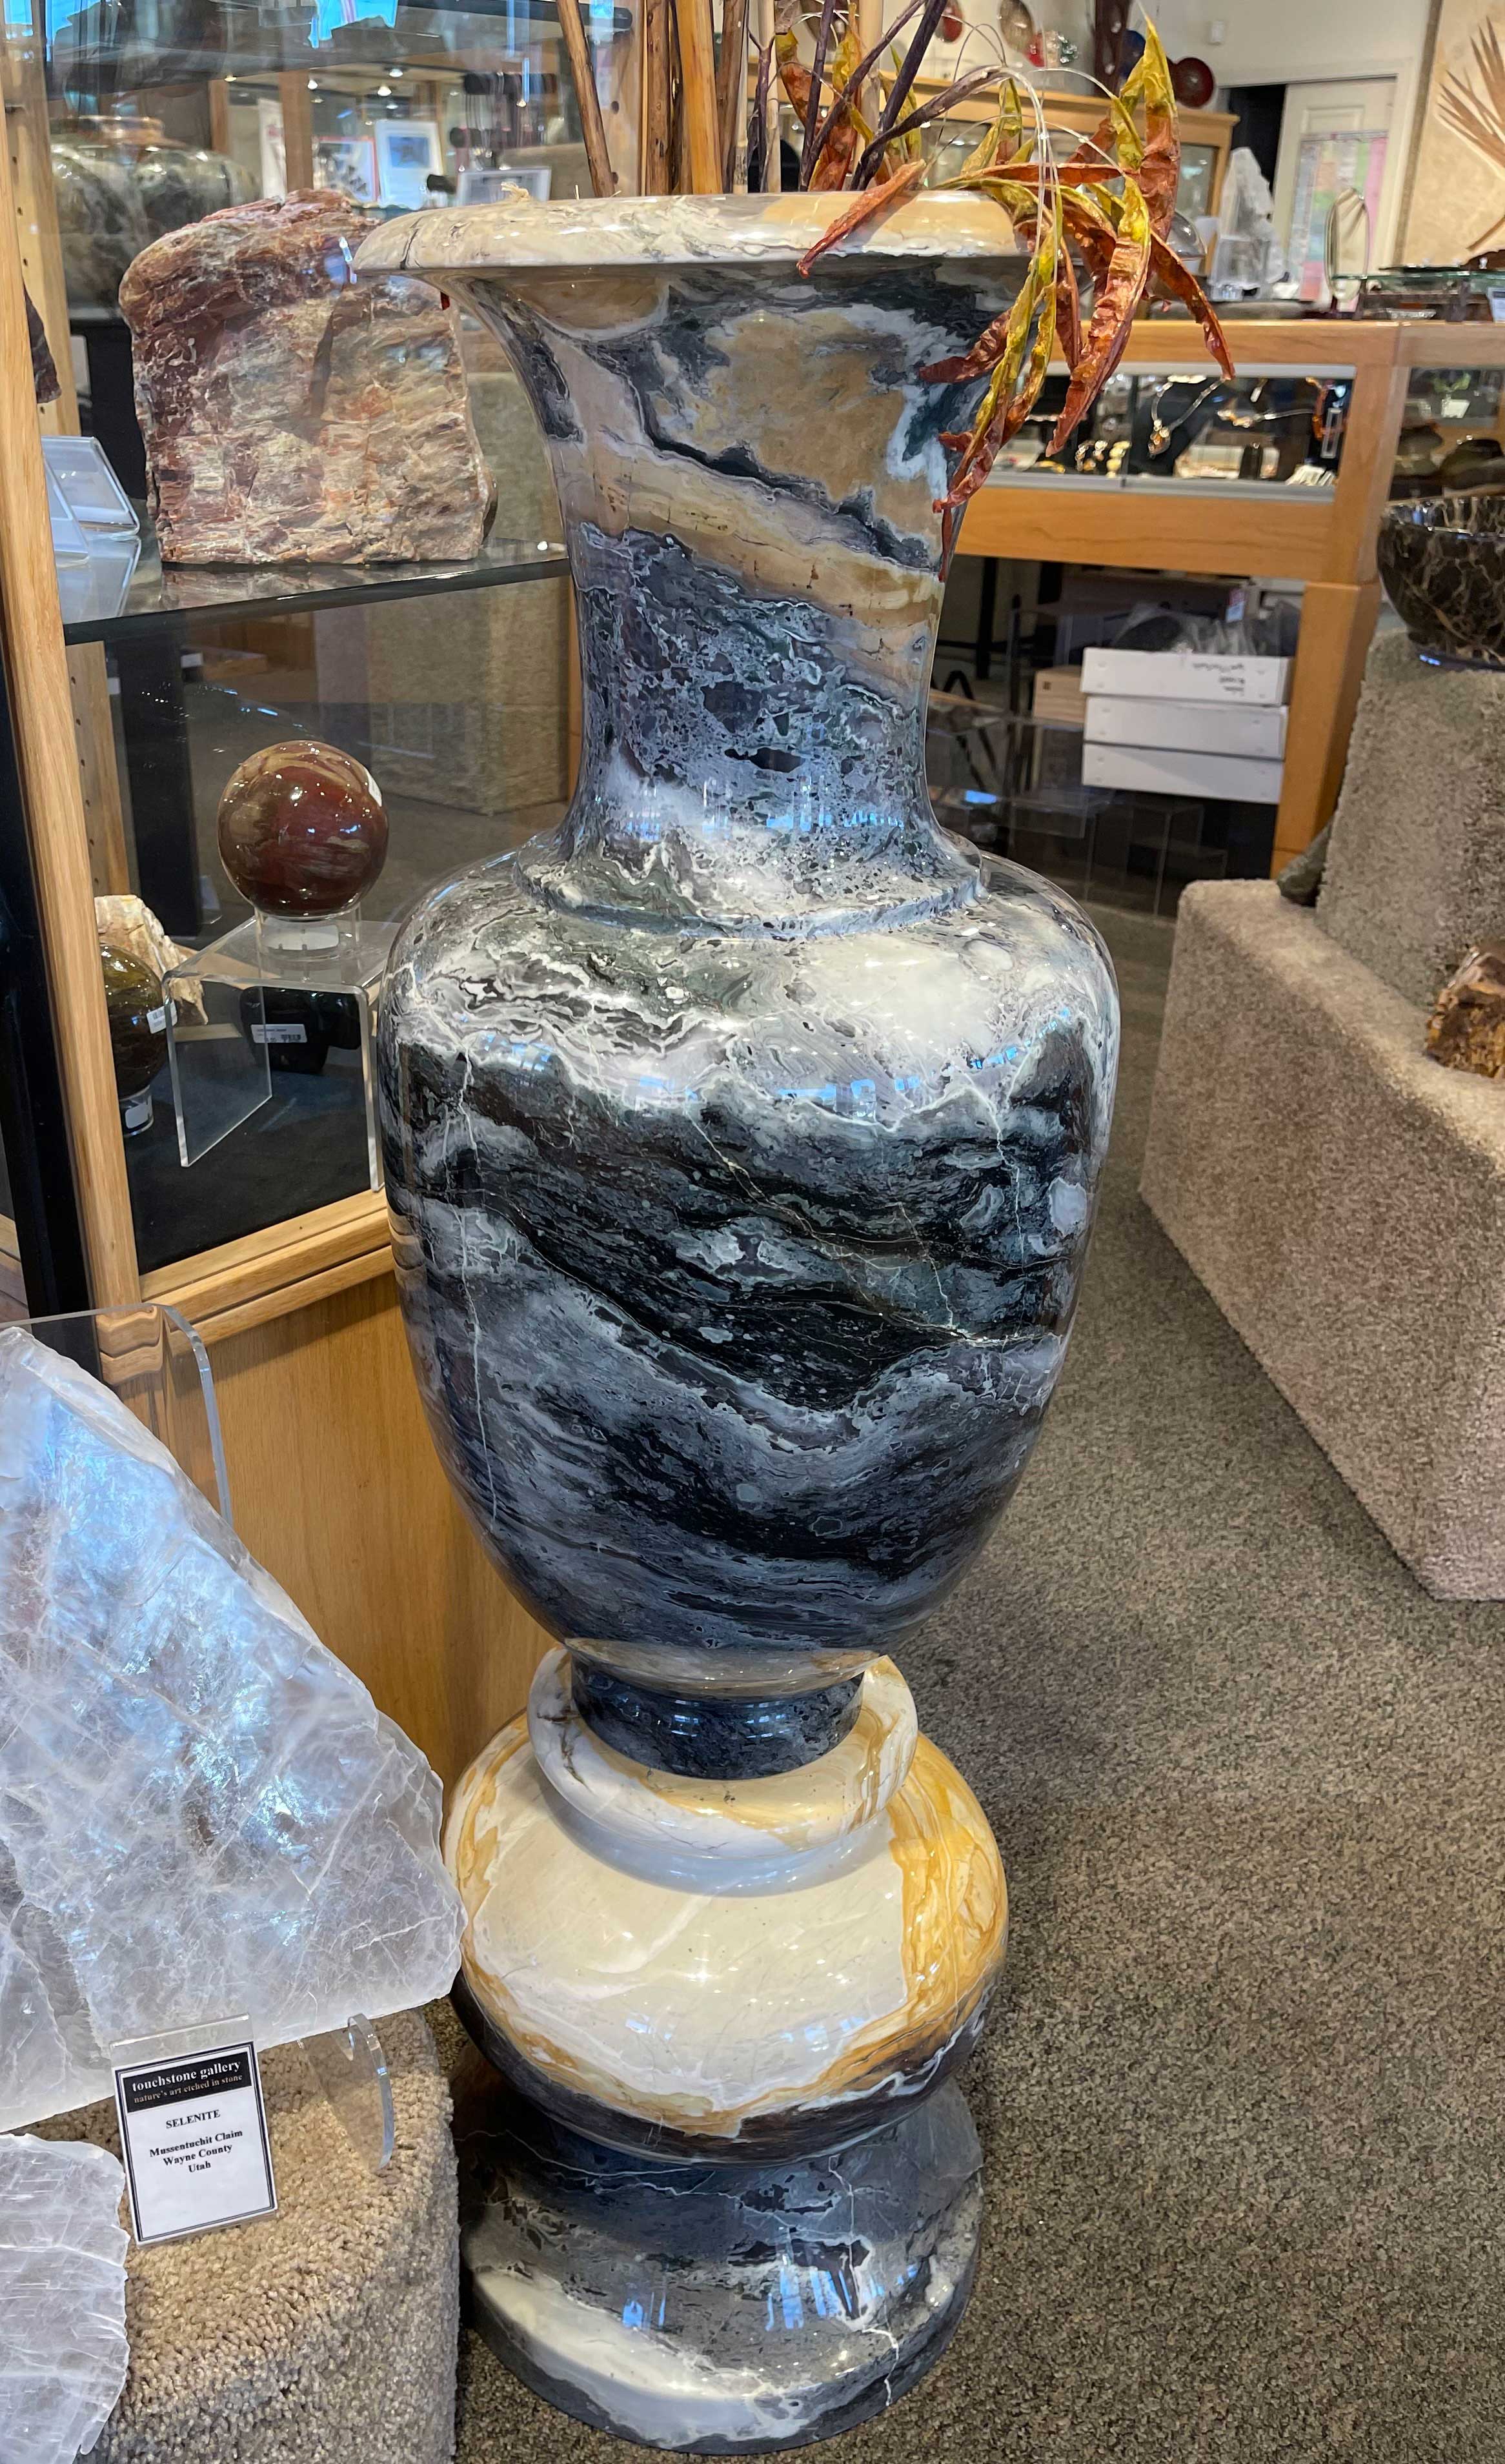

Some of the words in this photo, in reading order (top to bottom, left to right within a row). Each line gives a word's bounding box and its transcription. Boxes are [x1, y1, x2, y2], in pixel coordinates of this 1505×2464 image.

[132, 2070, 196, 2091] touchstone
[200, 2061, 241, 2079] gallery
[134, 2090, 168, 2103] nature's
[169, 2086, 181, 2096] art
[183, 2080, 209, 2093] etched
[221, 2074, 243, 2085] stone
[166, 2110, 221, 2128] SELENITE
[150, 2136, 212, 2157] Mussentuchit
[215, 2130, 243, 2142] Claim
[163, 2154, 196, 2166] Wayne
[199, 2145, 232, 2158] County
[188, 2161, 211, 2173] Utah
